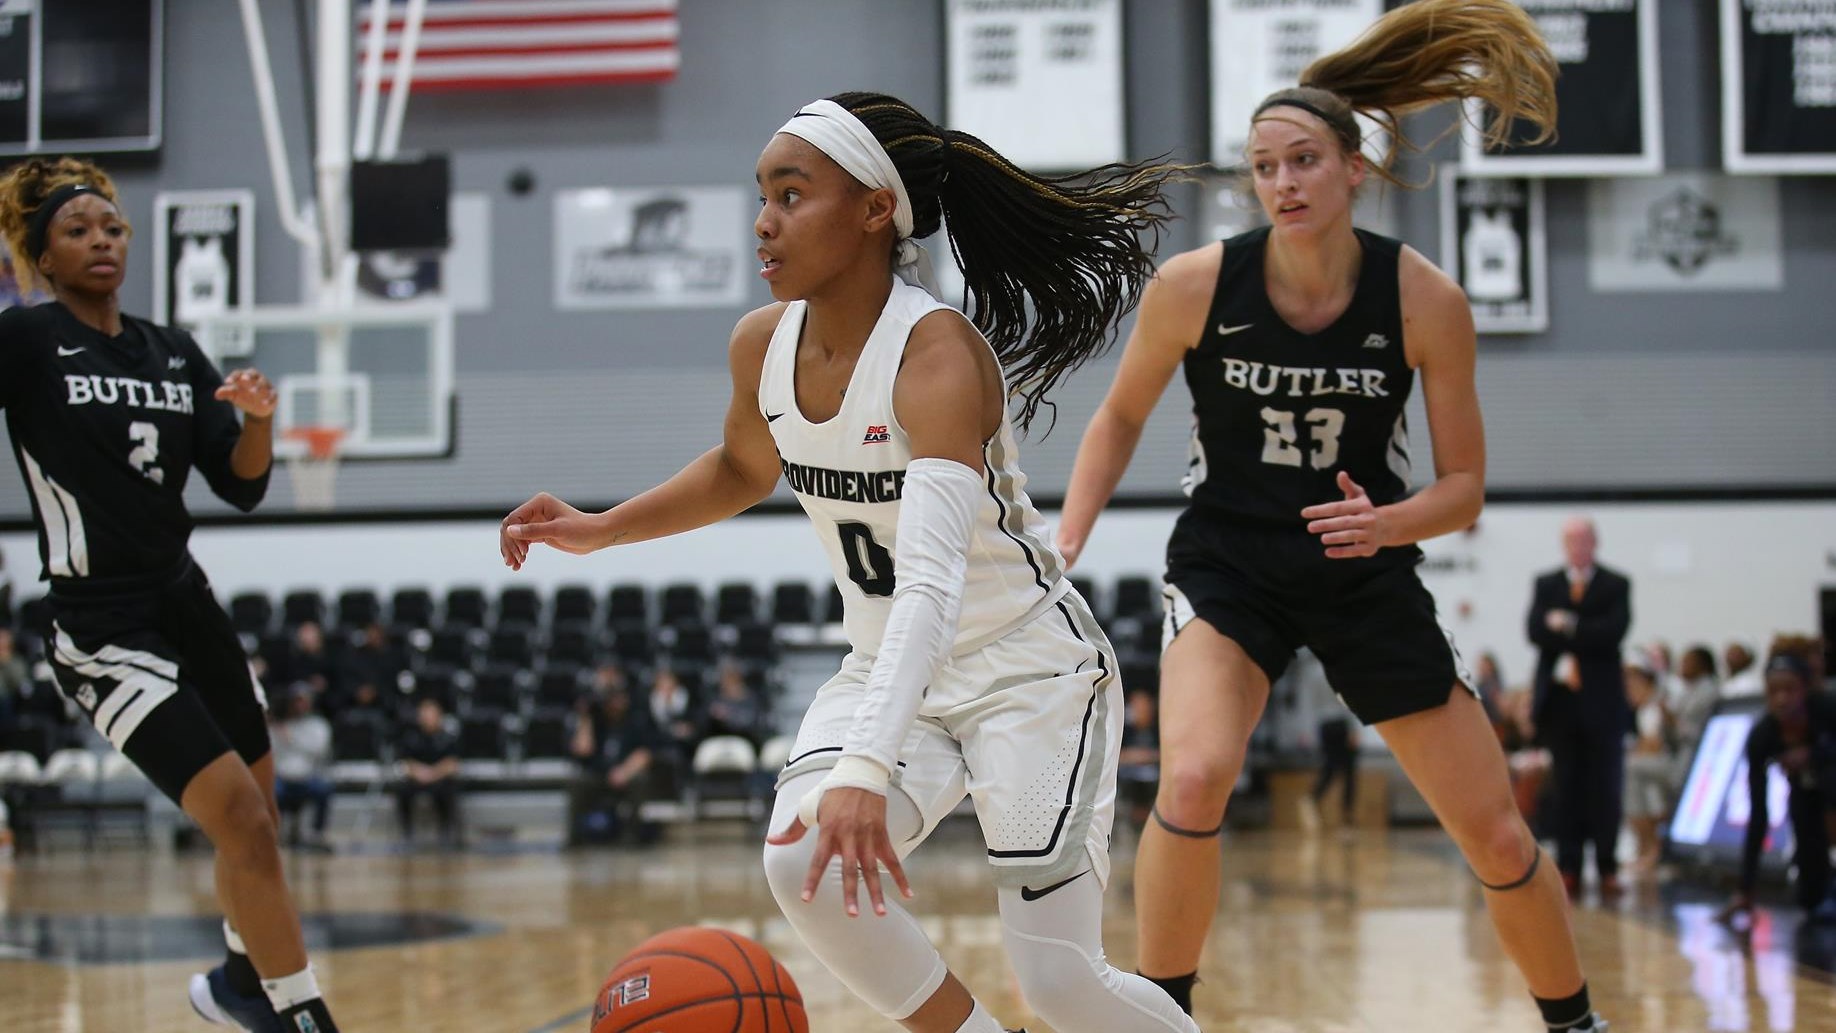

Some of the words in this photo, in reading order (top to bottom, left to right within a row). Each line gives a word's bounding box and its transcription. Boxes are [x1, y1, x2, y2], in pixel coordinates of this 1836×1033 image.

[64, 374, 194, 415] BUTLER
[1222, 358, 1389, 397] BUTLER
[128, 421, 164, 485] 2
[867, 425, 887, 434] BIG
[1260, 406, 1346, 470] 23
[777, 454, 907, 503] ROVIDENCE
[834, 519, 896, 598] 0
